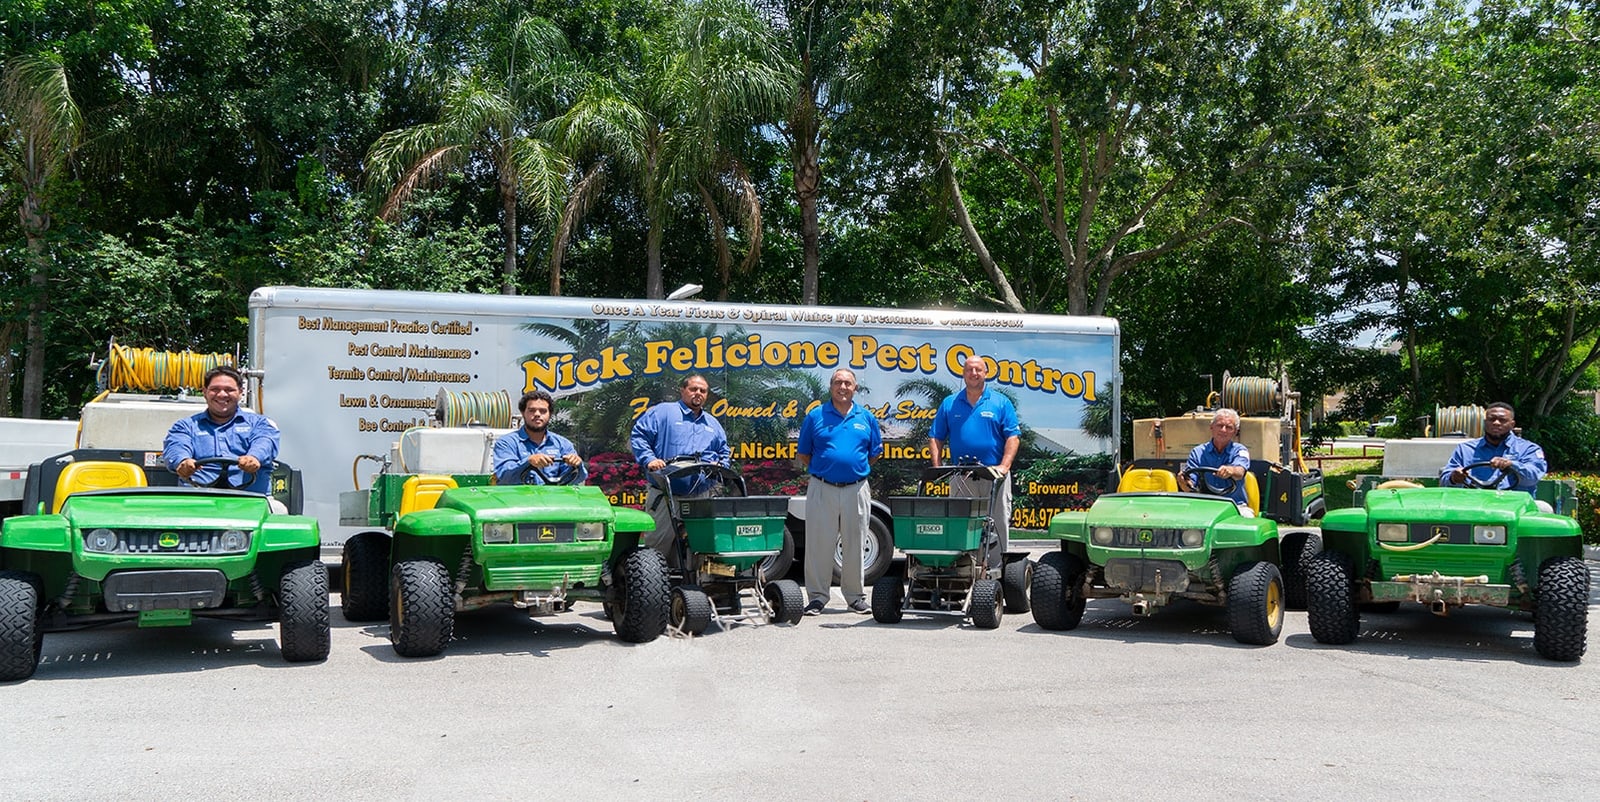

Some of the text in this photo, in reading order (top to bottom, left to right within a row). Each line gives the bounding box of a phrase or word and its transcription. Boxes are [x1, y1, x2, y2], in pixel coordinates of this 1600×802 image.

[592, 303, 630, 316] Once
[632, 304, 645, 316] A
[649, 305, 682, 318] Year
[685, 306, 724, 319] Ficus
[727, 307, 740, 319] &
[743, 309, 788, 322] Spiral
[790, 311, 833, 323] White
[298, 315, 472, 335] Best Management Practice Certified
[348, 342, 471, 360] Pest Control Maintenance
[328, 366, 471, 383] Termite Control/Maintenance
[521, 334, 1097, 402] Nick Felicione Pest Control
[340, 394, 438, 409] Lawn & Ornamenta
[710, 398, 777, 418] Owned
[781, 399, 799, 418] &
[895, 400, 938, 420] Sinc
[359, 417, 378, 432] Bee
[1029, 481, 1079, 495] Broward
[622, 492, 635, 504] In
[1280, 492, 1288, 503] 4
